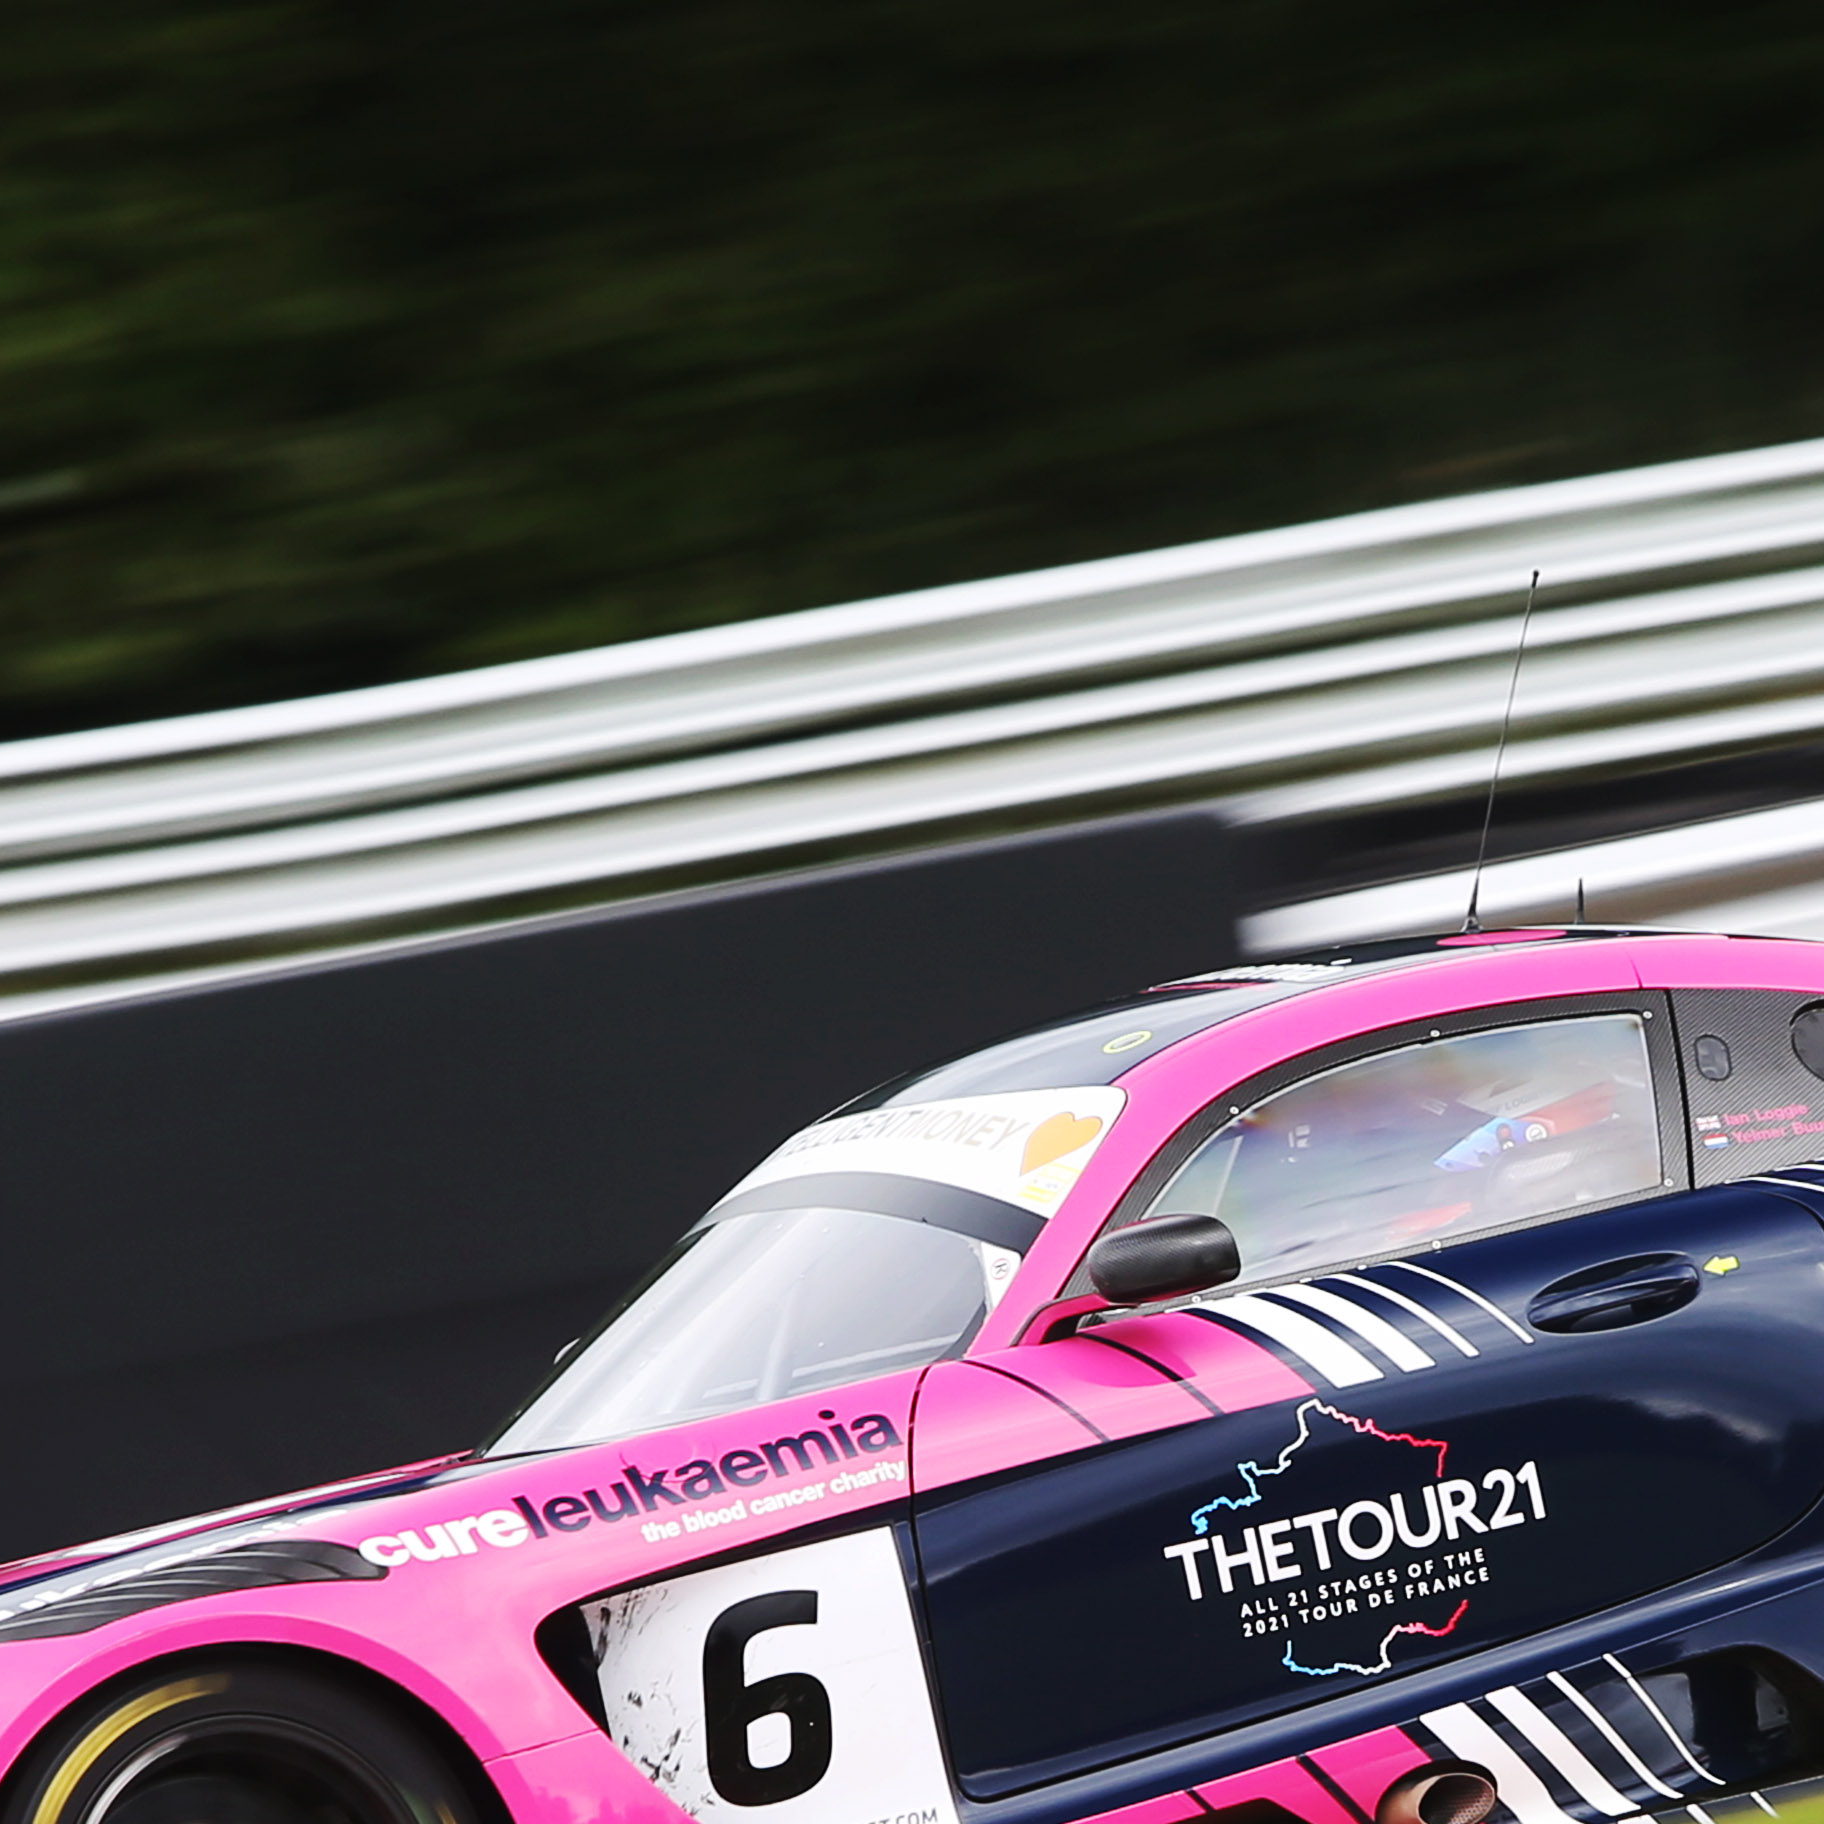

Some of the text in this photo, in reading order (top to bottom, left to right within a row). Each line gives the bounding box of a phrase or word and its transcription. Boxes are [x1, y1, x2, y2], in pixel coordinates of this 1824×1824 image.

[640, 1459, 908, 1544] the blood cancer charity
[1163, 1460, 1547, 1601] THETOUR21
[1240, 1547, 1486, 1619] ALL 21 STAGES OF THE
[1242, 1566, 1490, 1638] 2021 TOUR DE FRANCE
[702, 1590, 833, 1808] 6
